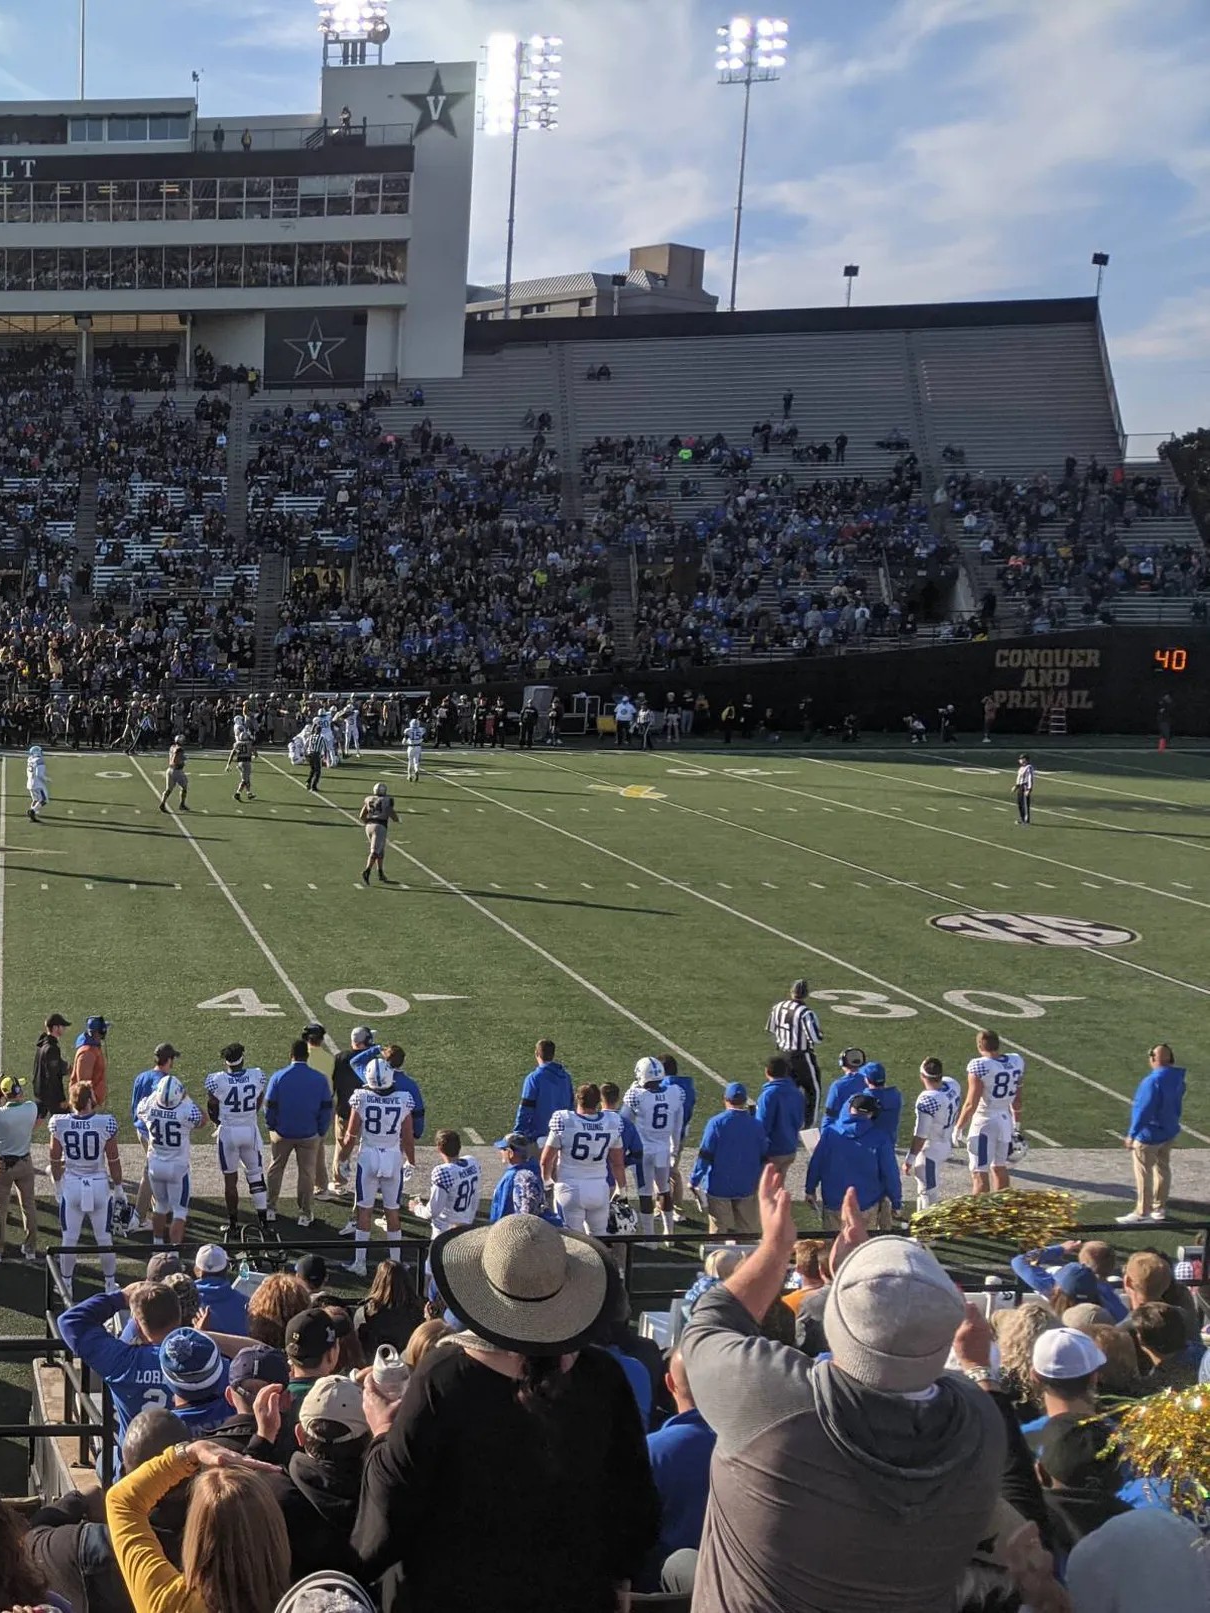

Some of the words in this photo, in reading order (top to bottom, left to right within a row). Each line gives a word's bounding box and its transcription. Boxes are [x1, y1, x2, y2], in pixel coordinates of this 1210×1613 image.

[425, 95, 445, 121] V
[995, 649, 1101, 668] CONQUER
[1155, 650, 1187, 671] 40
[1021, 669, 1070, 687] AND
[994, 689, 1093, 709] PREVAIL
[992, 1069, 1022, 1099] 83
[224, 1083, 257, 1113] 42
[654, 1094, 666, 1102] ALI
[71, 1120, 91, 1130] BATES
[364, 1105, 402, 1135] 87
[581, 1122, 604, 1132] YOUNG
[651, 1102, 669, 1129] 6
[63, 1131, 100, 1161] 80
[150, 1118, 182, 1148] 46
[570, 1132, 612, 1162] 67
